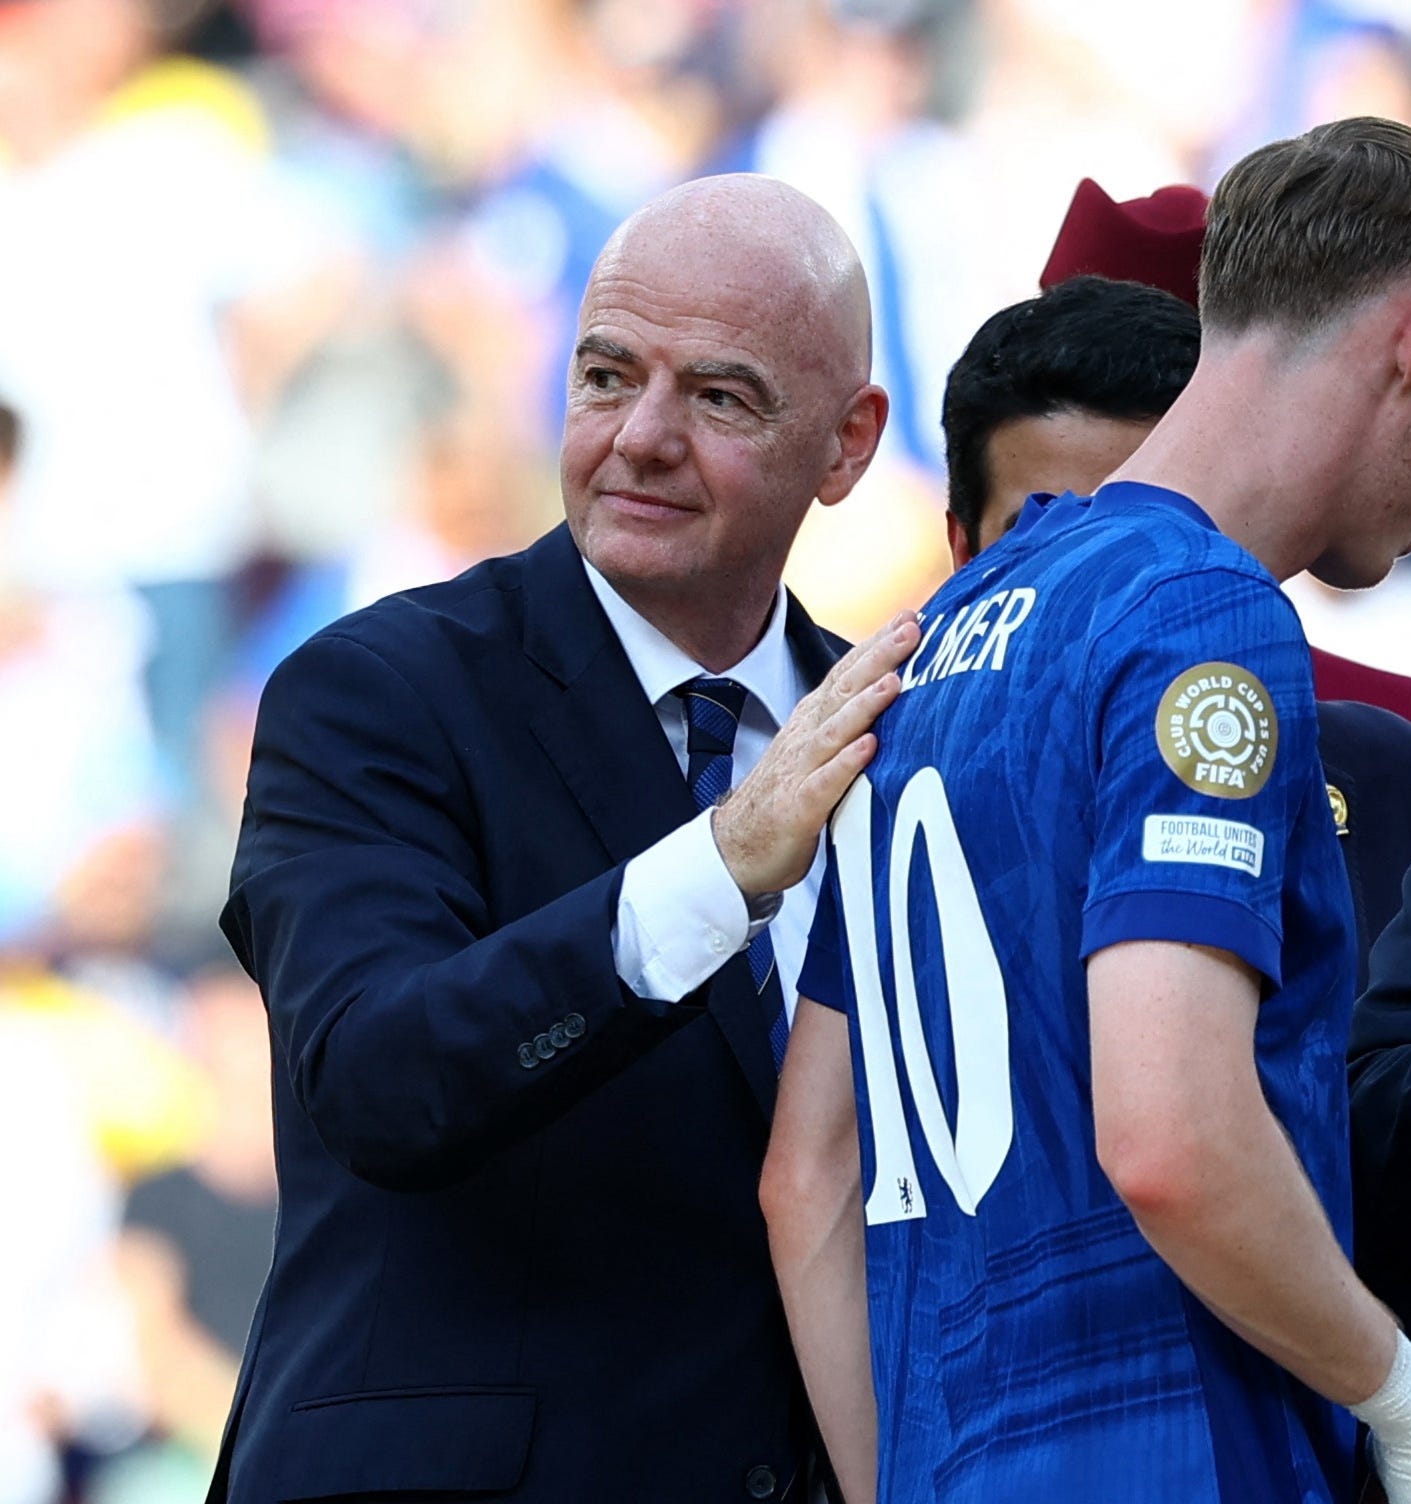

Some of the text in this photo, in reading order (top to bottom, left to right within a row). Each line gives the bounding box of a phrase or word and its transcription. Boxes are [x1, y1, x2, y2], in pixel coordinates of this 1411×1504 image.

[900, 587, 1036, 693] LMER
[1170, 676, 1269, 774] CLUB WORLD CUP 25 USA
[1195, 762, 1246, 789] FIFA
[1160, 838, 1229, 861] the World
[1161, 820, 1257, 848] FOOTBALL UNITES
[831, 766, 1013, 1226] 10
